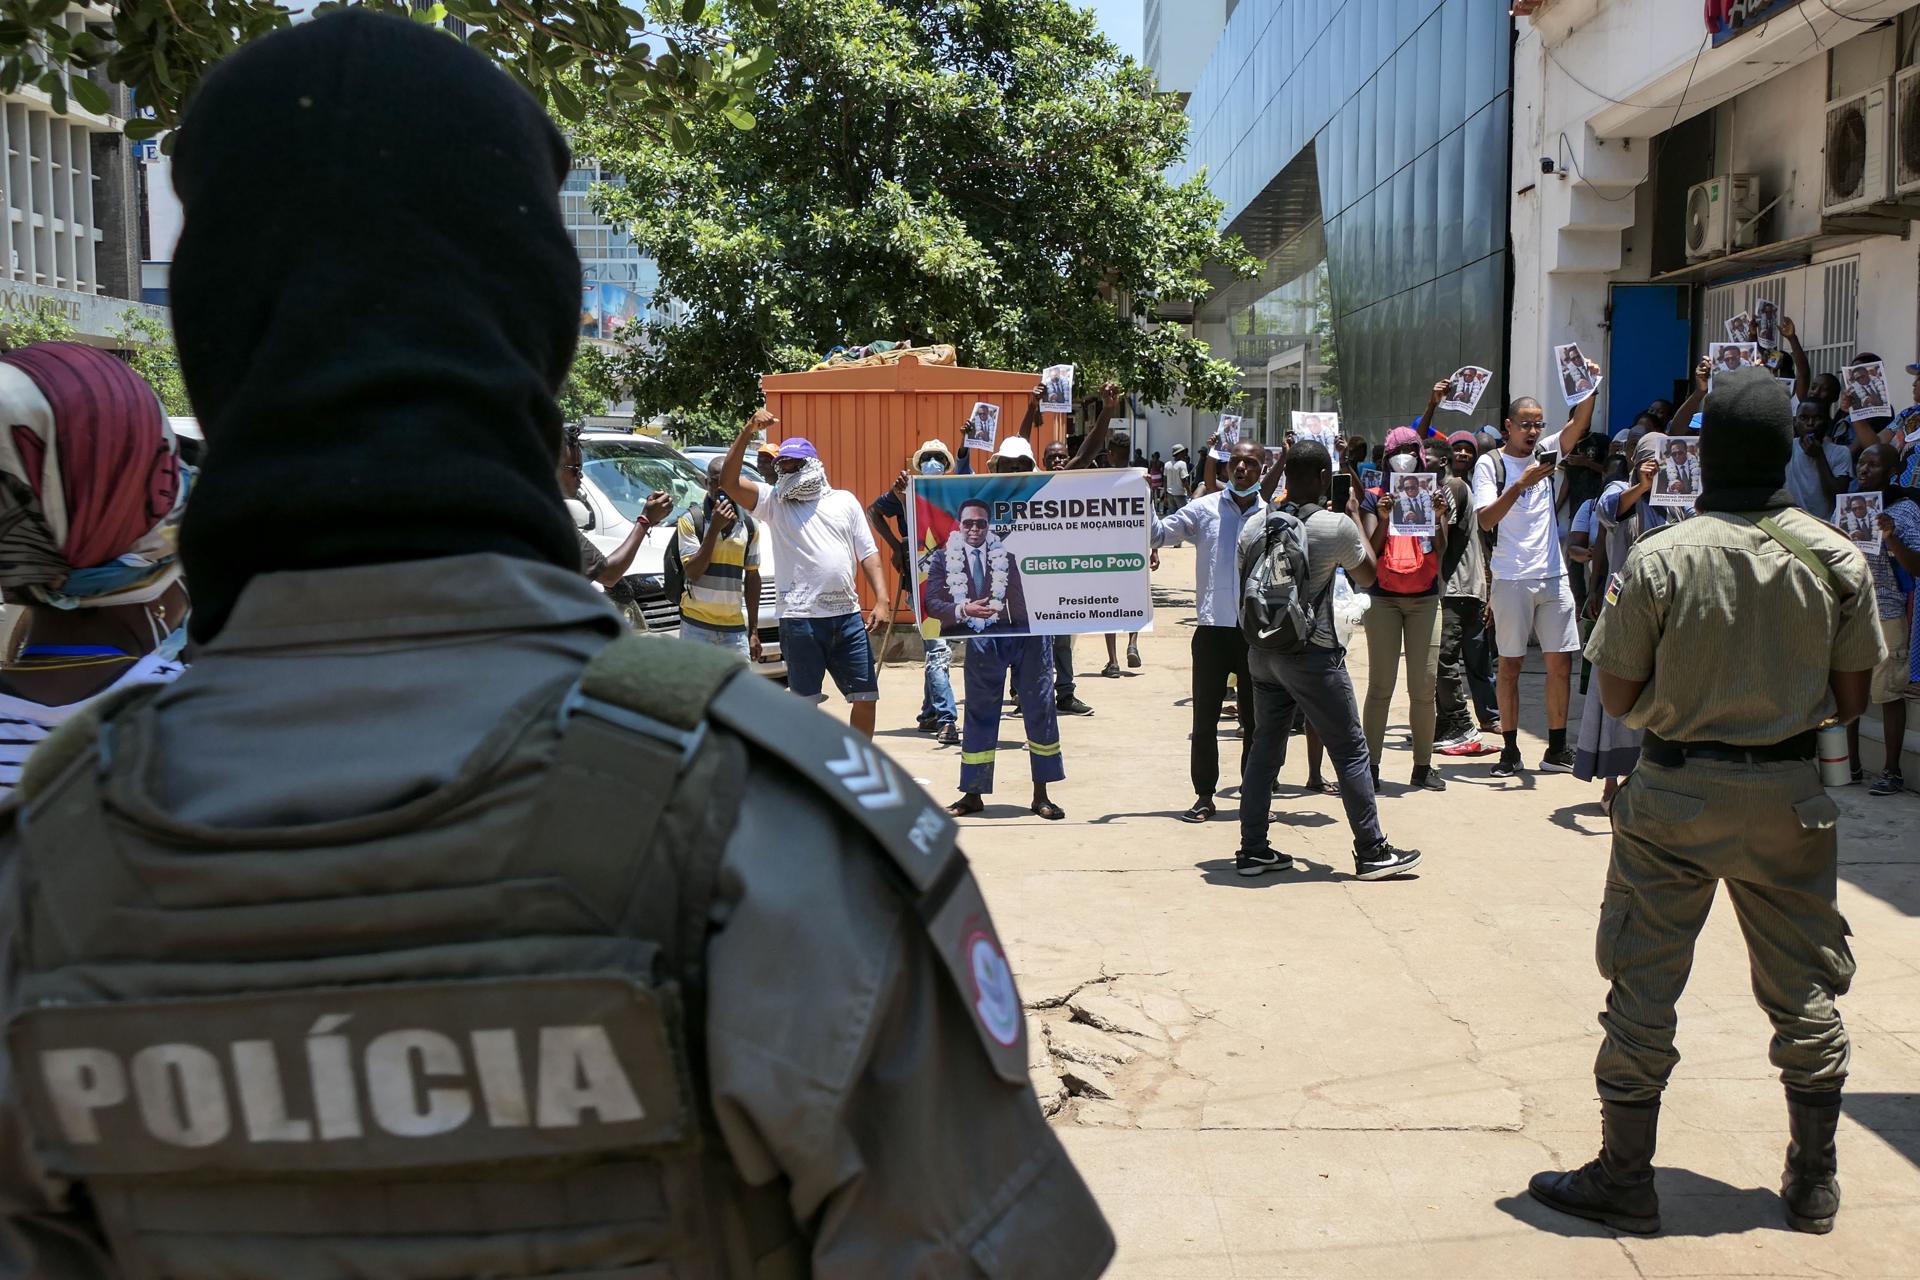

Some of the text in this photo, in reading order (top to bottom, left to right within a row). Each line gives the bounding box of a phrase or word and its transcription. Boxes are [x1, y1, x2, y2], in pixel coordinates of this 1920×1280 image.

[995, 498, 1145, 520] PRESIDENTE
[1011, 522, 1064, 532] REPÚBLICA
[1066, 521, 1079, 530] DE
[1080, 520, 1145, 531] MOÇAMBIQUE
[1025, 557, 1142, 571] Eleito Pelo Povo
[1058, 596, 1119, 606] Presidente
[1035, 609, 1144, 620] Venâncio Mondlane
[41, 1014, 645, 1147] POLÍCIA
